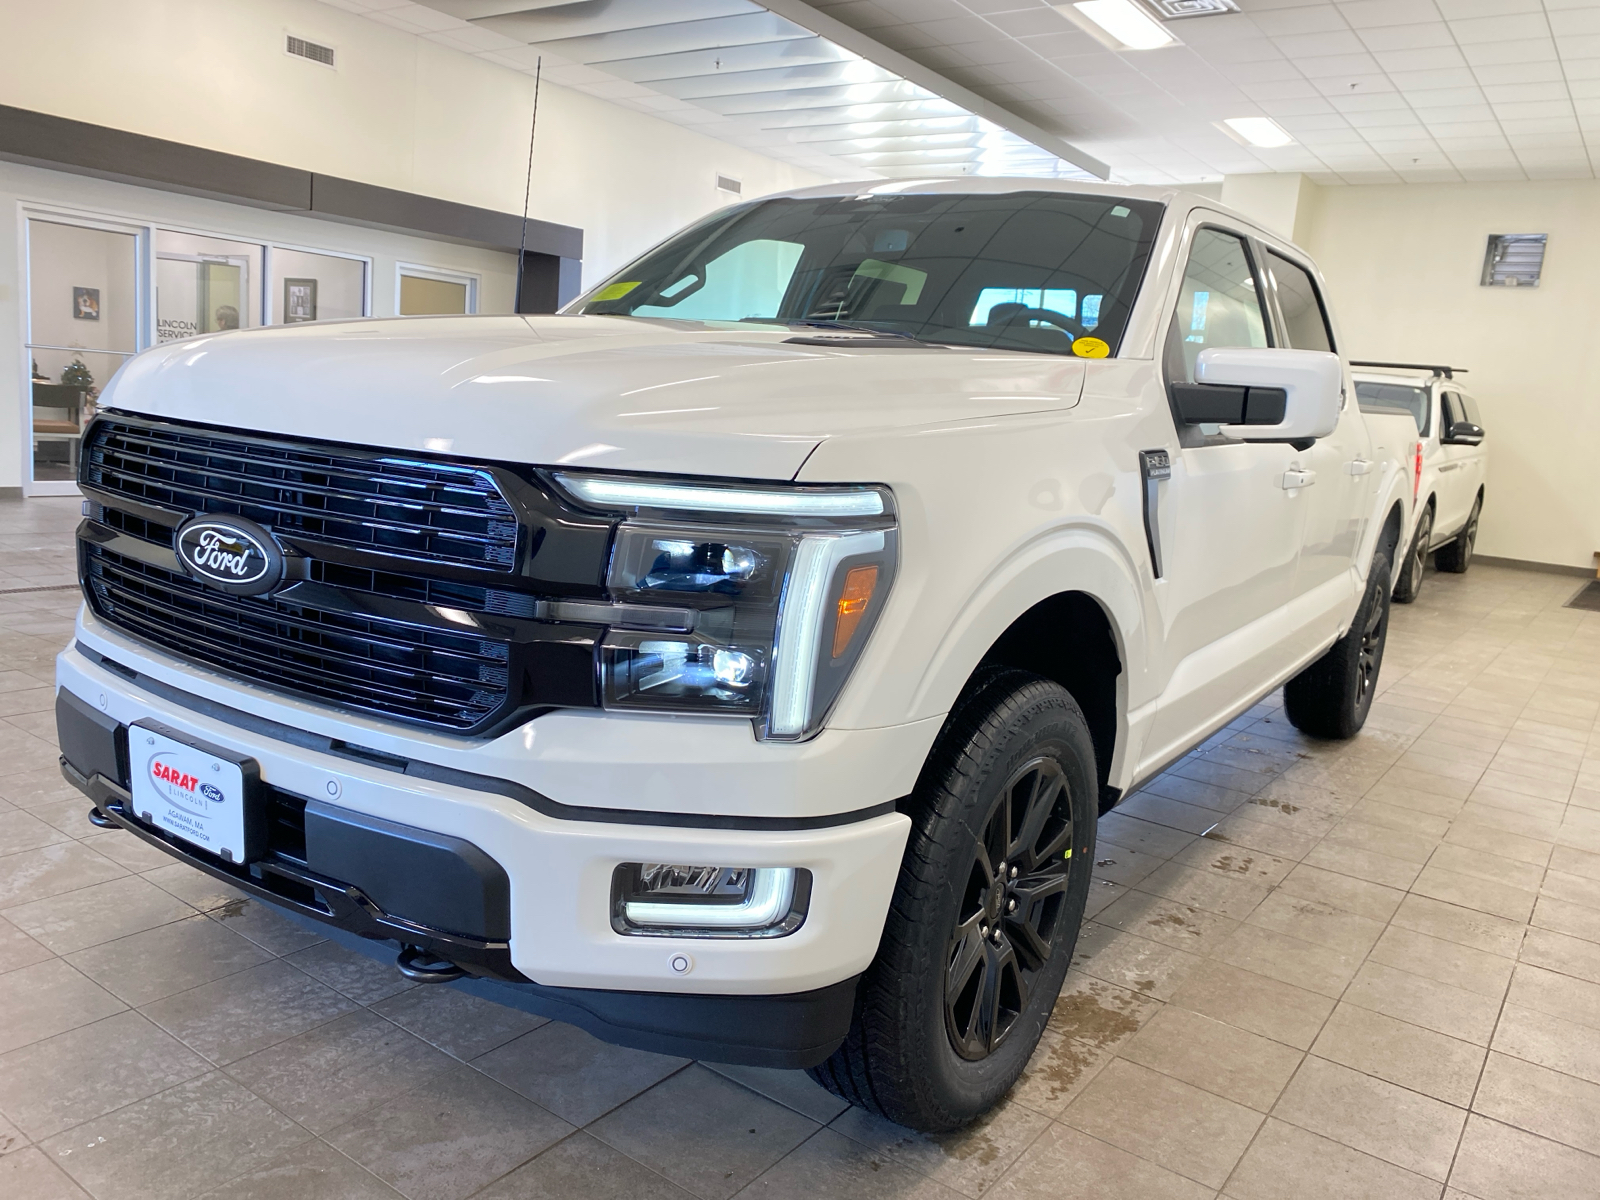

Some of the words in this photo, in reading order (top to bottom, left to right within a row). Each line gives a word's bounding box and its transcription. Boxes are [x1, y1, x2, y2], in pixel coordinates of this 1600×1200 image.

[158, 319, 197, 330] LINCOLN
[158, 330, 194, 338] SERVICE
[194, 530, 250, 576] Ford
[153, 761, 199, 793] SARAT
[173, 790, 203, 806] LINCOLN
[203, 785, 221, 801] Ford
[194, 821, 204, 831] MA
